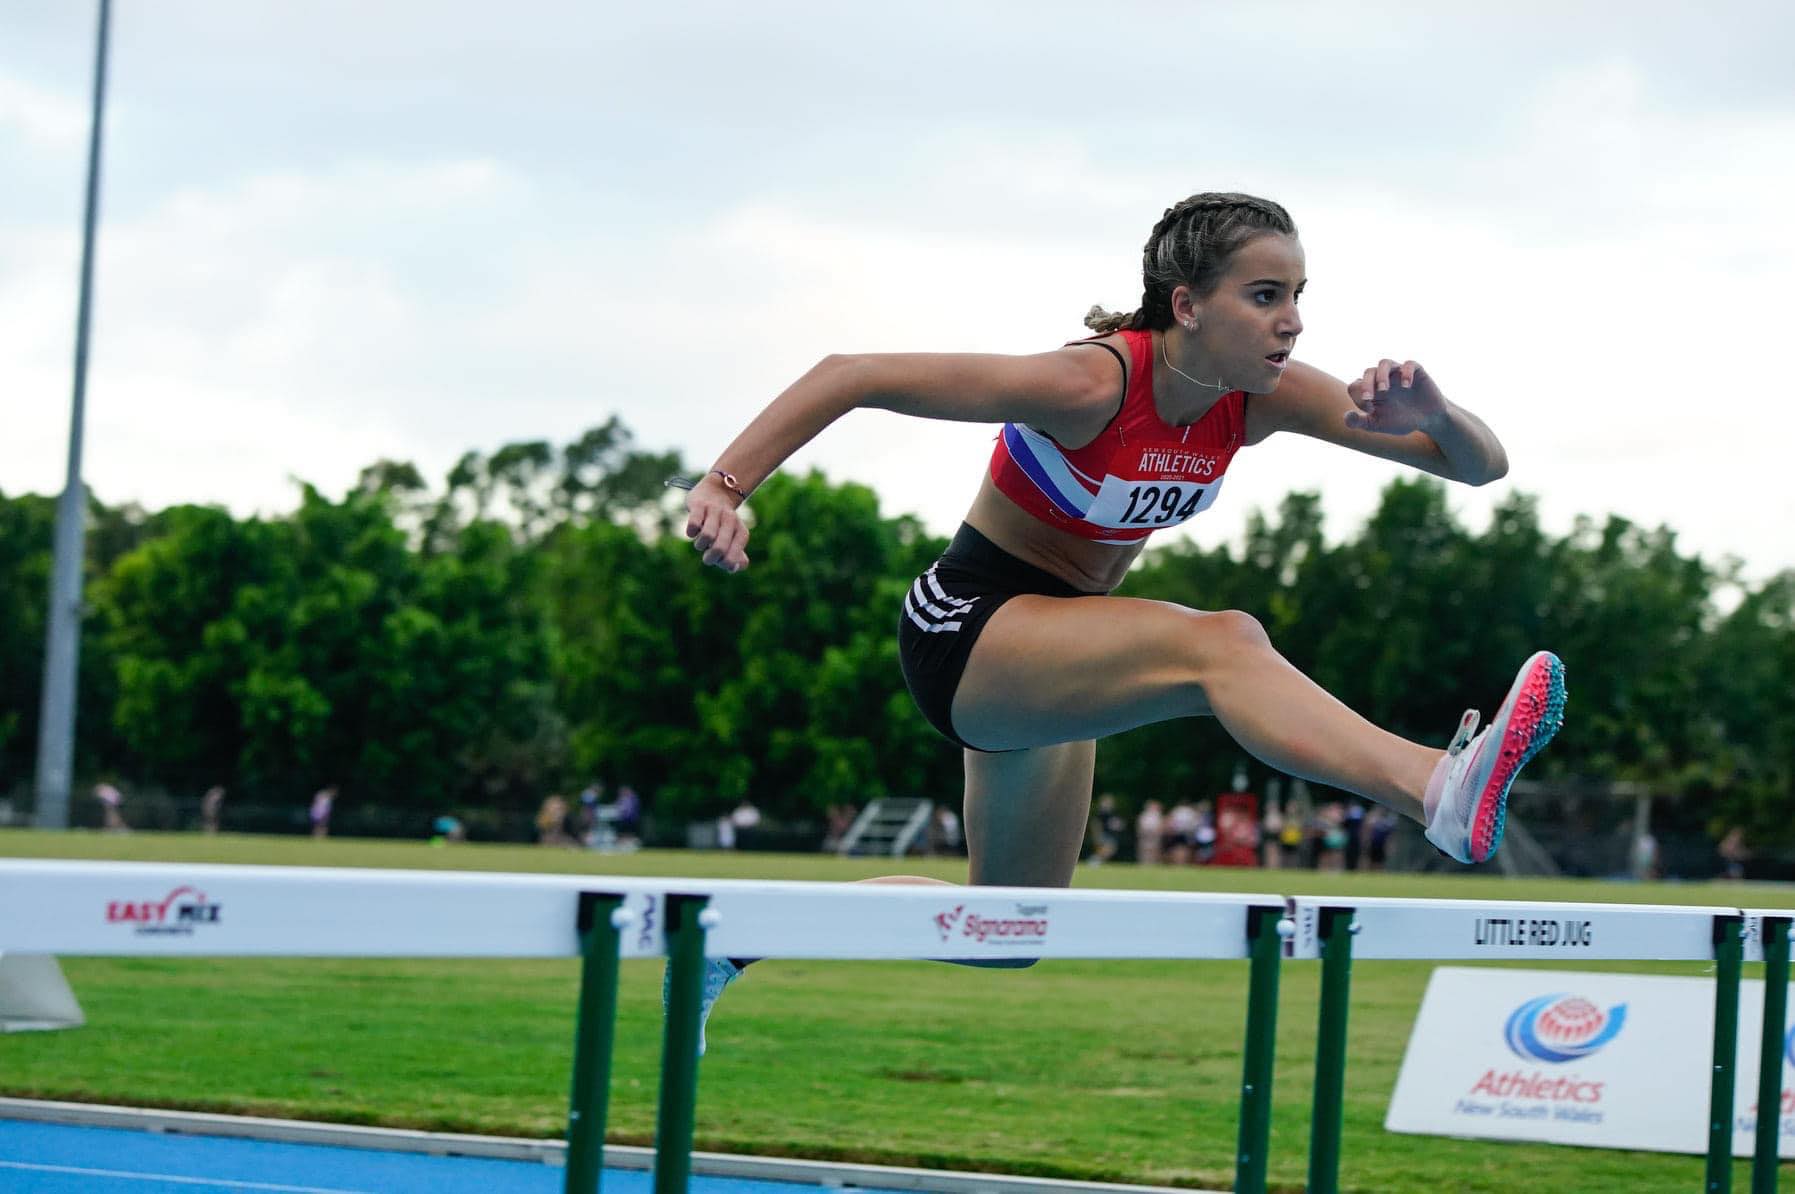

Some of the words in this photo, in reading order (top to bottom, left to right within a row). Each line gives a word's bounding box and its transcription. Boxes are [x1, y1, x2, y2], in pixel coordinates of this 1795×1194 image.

[1138, 453, 1216, 476] ATHLETICS
[1120, 486, 1204, 524] 1294
[107, 900, 167, 923] EASY
[177, 904, 221, 922] MIX
[963, 914, 1048, 942] Signarama
[1474, 918, 1525, 946] LITTLE
[1528, 919, 1560, 946] RED
[1562, 920, 1592, 947] JUG
[1469, 1069, 1605, 1104] Athletics
[1454, 1099, 1494, 1115] New
[1499, 1100, 1549, 1118] South
[1553, 1104, 1604, 1124] Wales
